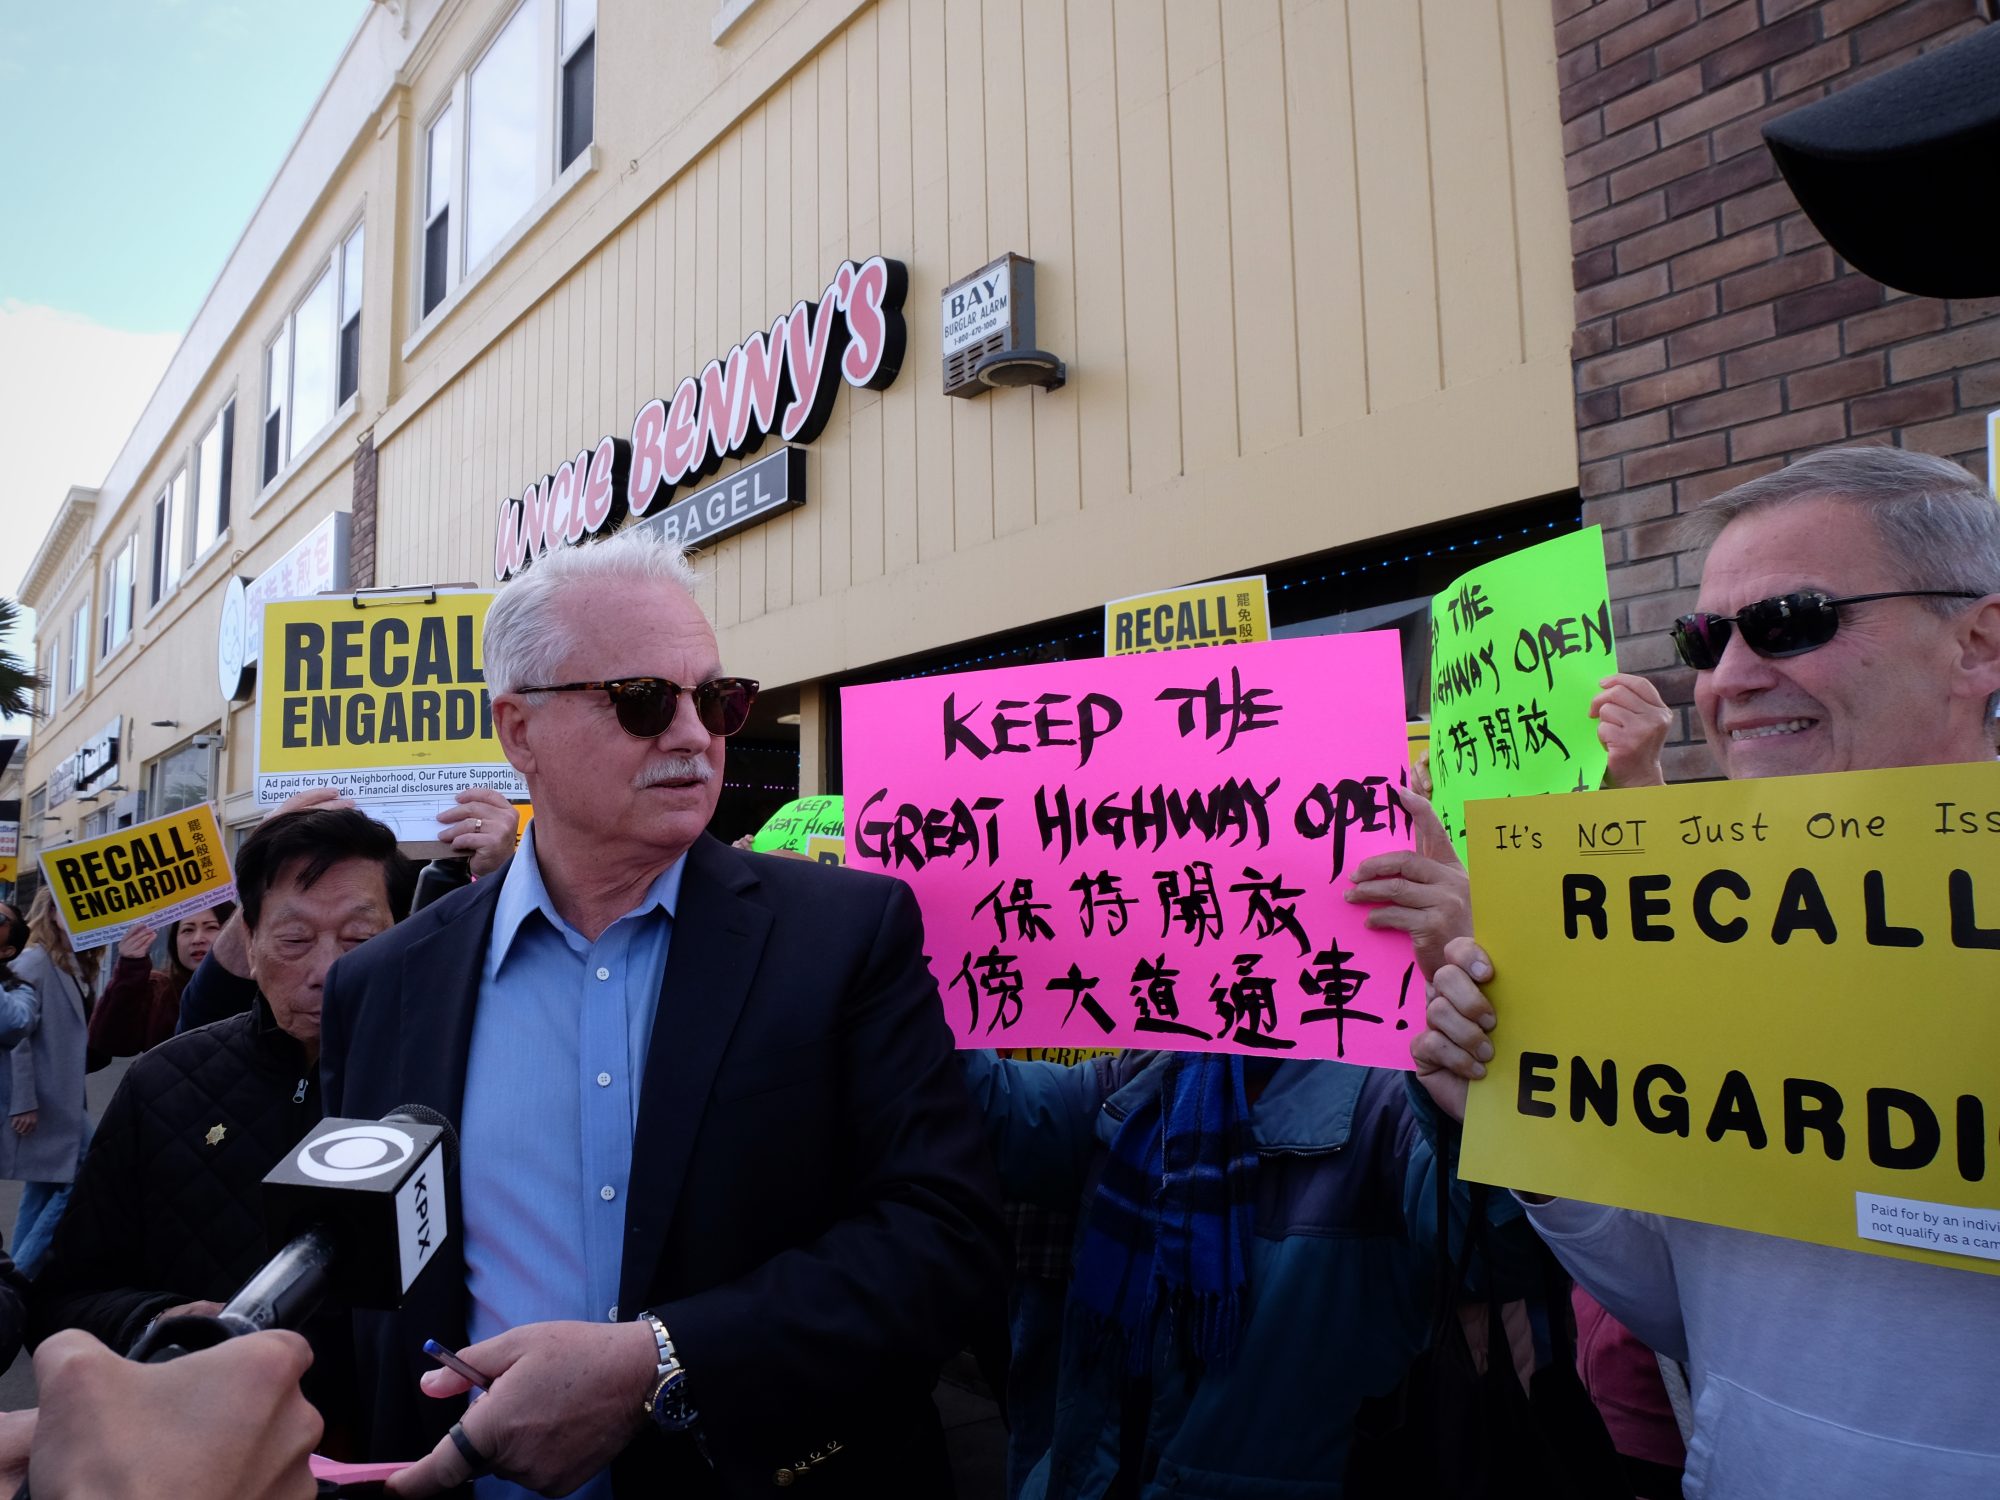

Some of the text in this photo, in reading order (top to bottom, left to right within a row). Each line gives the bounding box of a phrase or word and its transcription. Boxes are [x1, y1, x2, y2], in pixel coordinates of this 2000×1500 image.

[945, 295, 1007, 338] BURGLAR ALARM
[951, 274, 999, 319] BAY
[495, 255, 888, 581] UNCLE BENNY'S
[664, 472, 771, 545] BAGEL
[1115, 596, 1237, 651] RECALL
[1448, 582, 1494, 635] THE
[284, 615, 485, 692] RECAL
[1434, 640, 1502, 706] GHWAY
[1515, 600, 1613, 692] OPEN
[282, 688, 493, 748] ENGARDI
[944, 666, 1283, 770] KEEP THE
[261, 790, 300, 801] Supervi
[359, 784, 399, 795] Financial
[401, 782, 454, 793] disclosures
[456, 782, 470, 791] are
[514, 781, 523, 790] at
[265, 780, 278, 788] Ad
[281, 779, 300, 789] paid
[302, 777, 314, 786] for
[318, 776, 328, 787] by
[331, 775, 348, 785] Our
[350, 771, 416, 786] Neighborhood,
[418, 771, 436, 780] Our
[438, 769, 467, 780] Future
[792, 800, 832, 820] KEEP
[802, 817, 845, 836] HIGH
[855, 788, 1004, 872] GREAT
[1034, 777, 1281, 864] HIGHWAY
[1295, 764, 1413, 885] OPEN
[1495, 803, 2000, 850] It's NOT Just One Iss
[56, 826, 195, 895] RECALL
[69, 859, 202, 922] ENGARDIO
[972, 860, 1310, 957] 保持開放
[1562, 867, 2000, 950] RECALL
[923, 938, 1418, 1057] 傍大道通車!
[1517, 1051, 2000, 1183] ENGARDI
[414, 1173, 431, 1260] KPIX
[1871, 1203, 2000, 1232] Paid for by an indivi
[1872, 1222, 2000, 1250] not qualify as a cam
